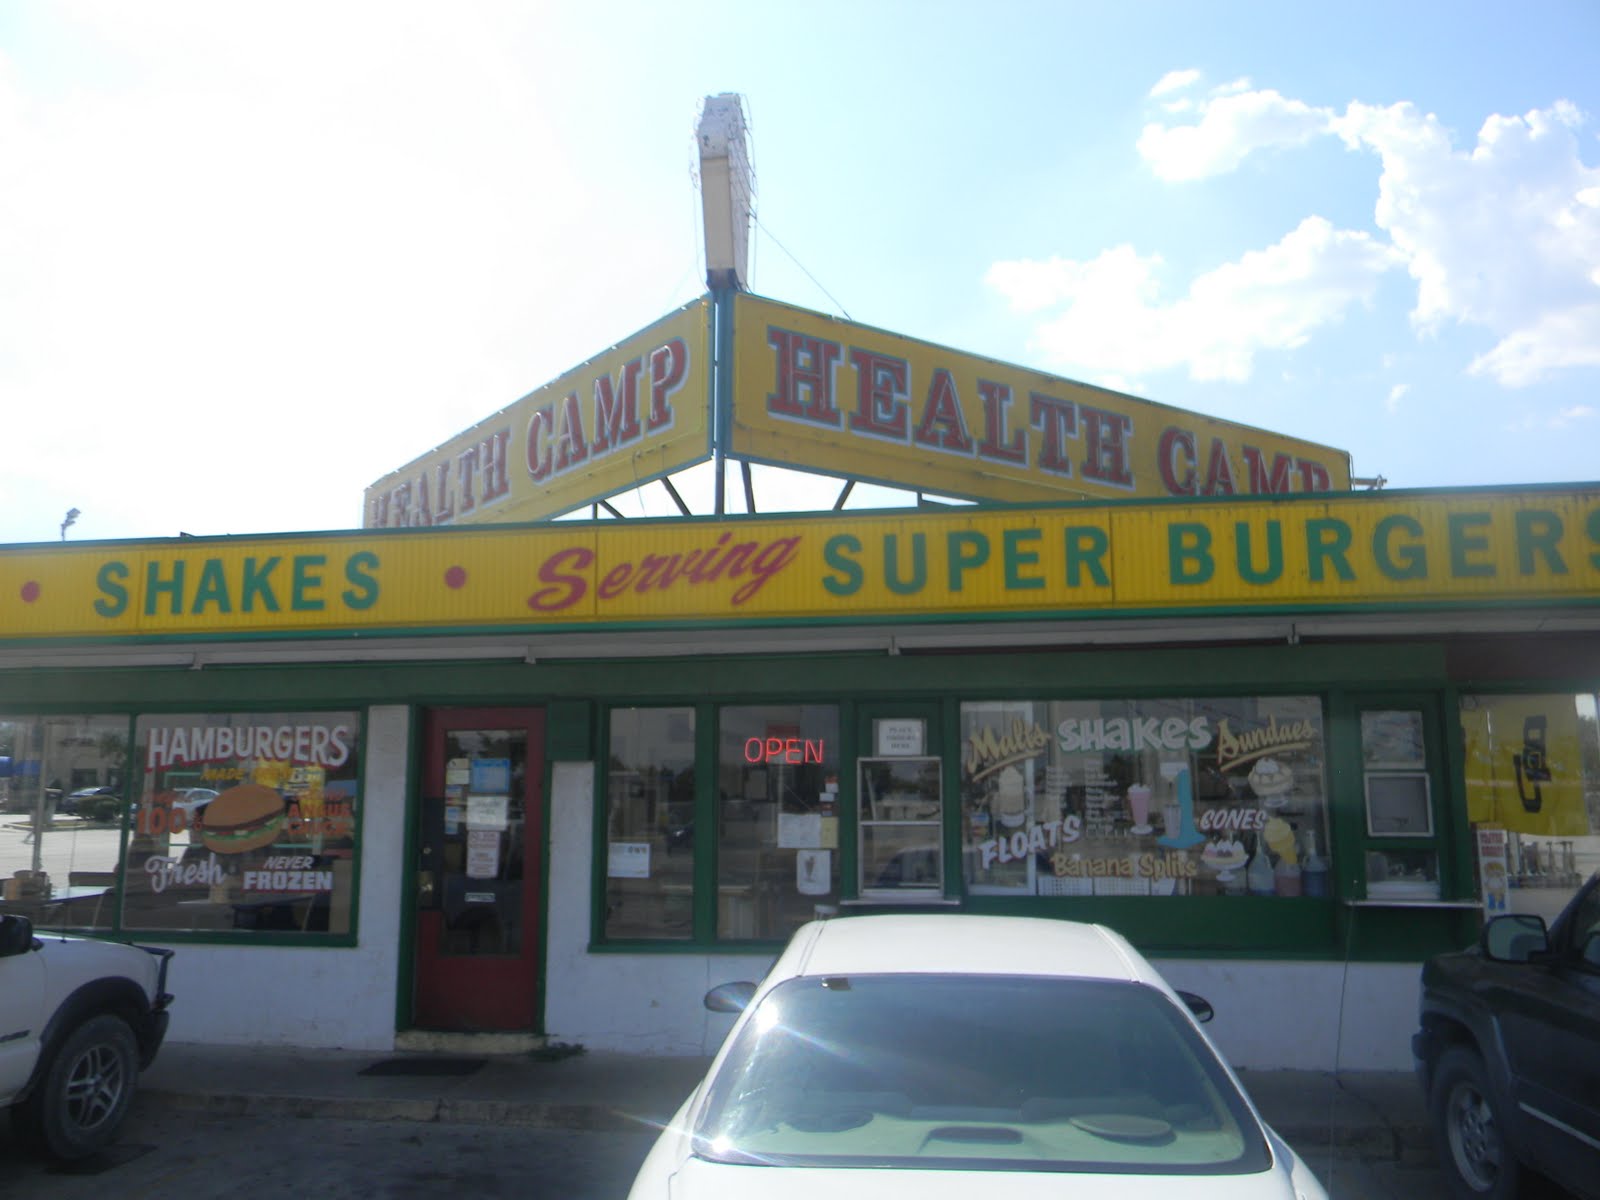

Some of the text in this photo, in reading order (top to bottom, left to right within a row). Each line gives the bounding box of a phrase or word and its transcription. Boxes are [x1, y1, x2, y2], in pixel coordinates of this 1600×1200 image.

[371, 337, 688, 529] HEALTH CAMP
[767, 325, 1332, 495] HEALTH CAMP
[527, 508, 1600, 612] Serving SUPER BURGER
[93, 551, 380, 618] SHAKES
[146, 725, 349, 770] HAMBURGERS
[744, 737, 824, 764] OPEN
[968, 718, 1051, 774] Malts
[1217, 715, 1317, 765] Sundaes
[978, 814, 1081, 870] FLOATS
[1201, 808, 1267, 830] CONES
[144, 852, 226, 892] Fresh
[243, 871, 333, 891] FROZEN
[264, 856, 314, 869] NEVER
[1051, 853, 1198, 882] Banana Splits
